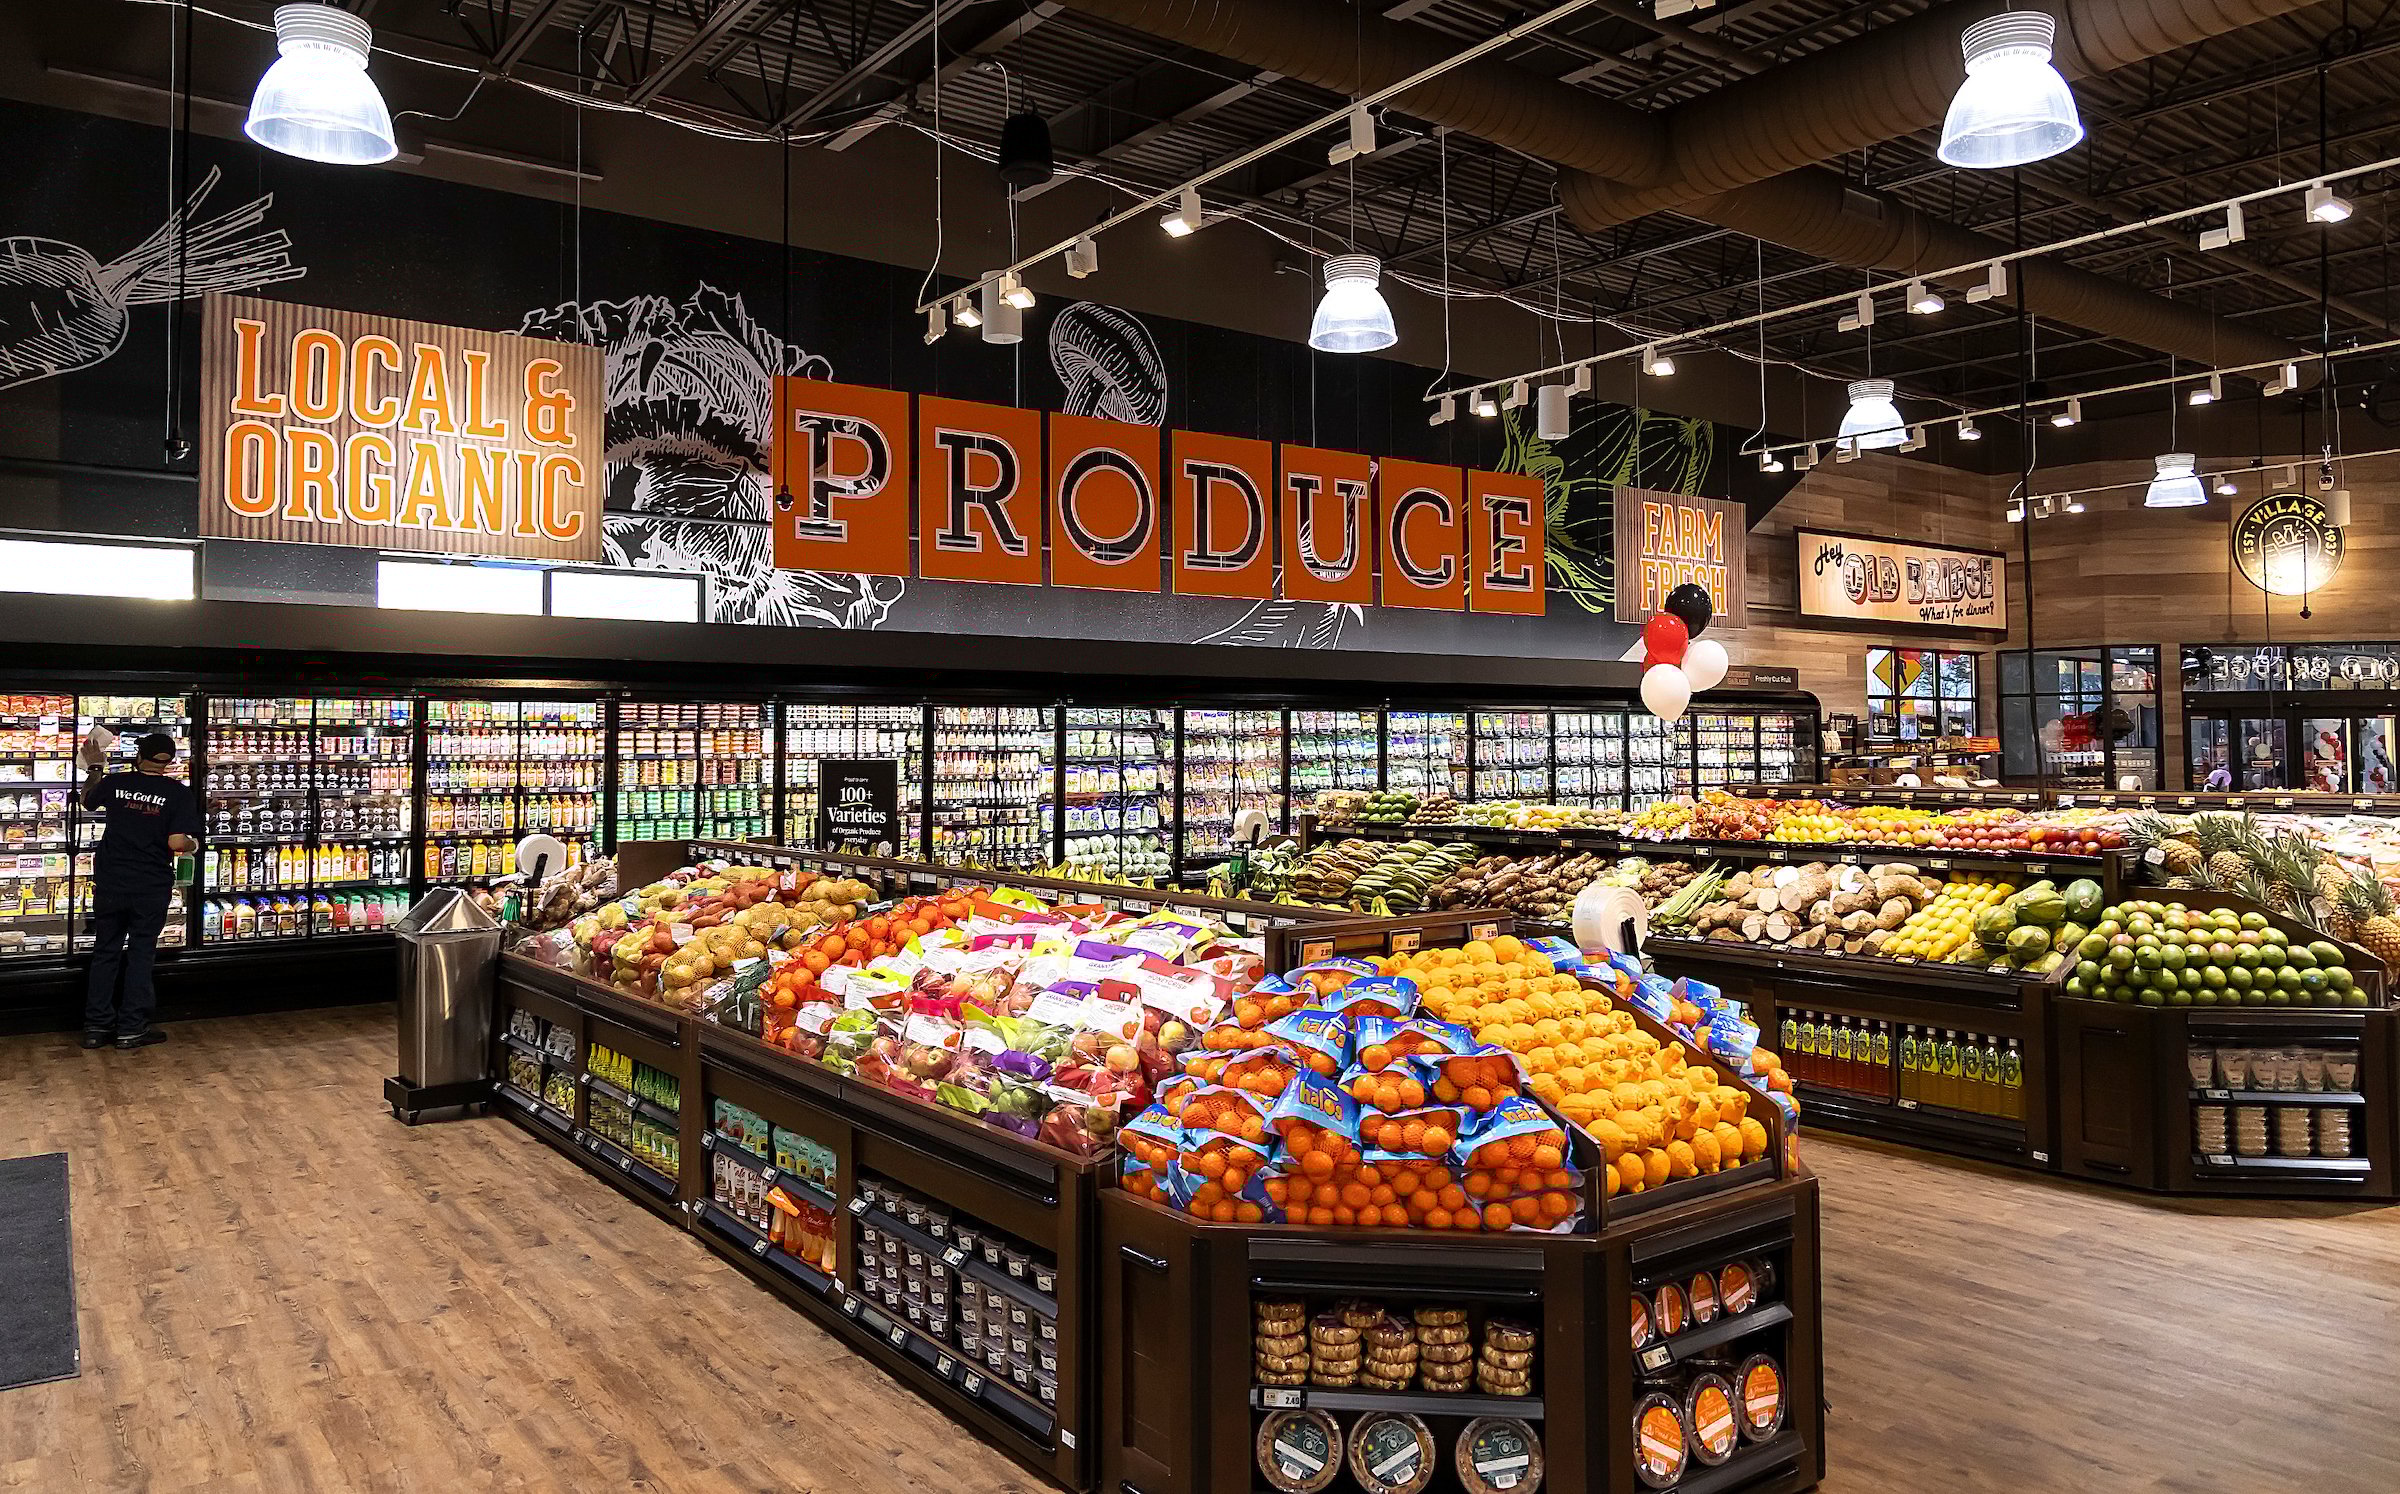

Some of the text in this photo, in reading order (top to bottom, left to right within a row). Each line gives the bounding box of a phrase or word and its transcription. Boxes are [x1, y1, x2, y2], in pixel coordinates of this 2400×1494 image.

[231, 318, 577, 449] LOCAL &
[224, 420, 585, 542] ORGANIC
[794, 408, 1535, 593] PRODUCE
[2249, 500, 2326, 525] VILLAGE
[1642, 500, 1725, 563] FARM
[2243, 531, 2255, 555] EST
[2323, 528, 2337, 557] 1937
[1814, 542, 1844, 576] Hey
[1843, 553, 1994, 604] OLD BRIDGE
[1919, 606, 1950, 622] What's
[1755, 675, 1771, 683] Freshly
[115, 789, 166, 806] We Got It!
[840, 786, 873, 802] 100+
[827, 806, 887, 824] Varieties
[839, 827, 858, 836] Organic
[859, 828, 881, 836] Produce
[1300, 1080, 1344, 1122] halos
[1500, 1100, 1550, 1124] halo
[1285, 1396, 1300, 1405] 2.49
